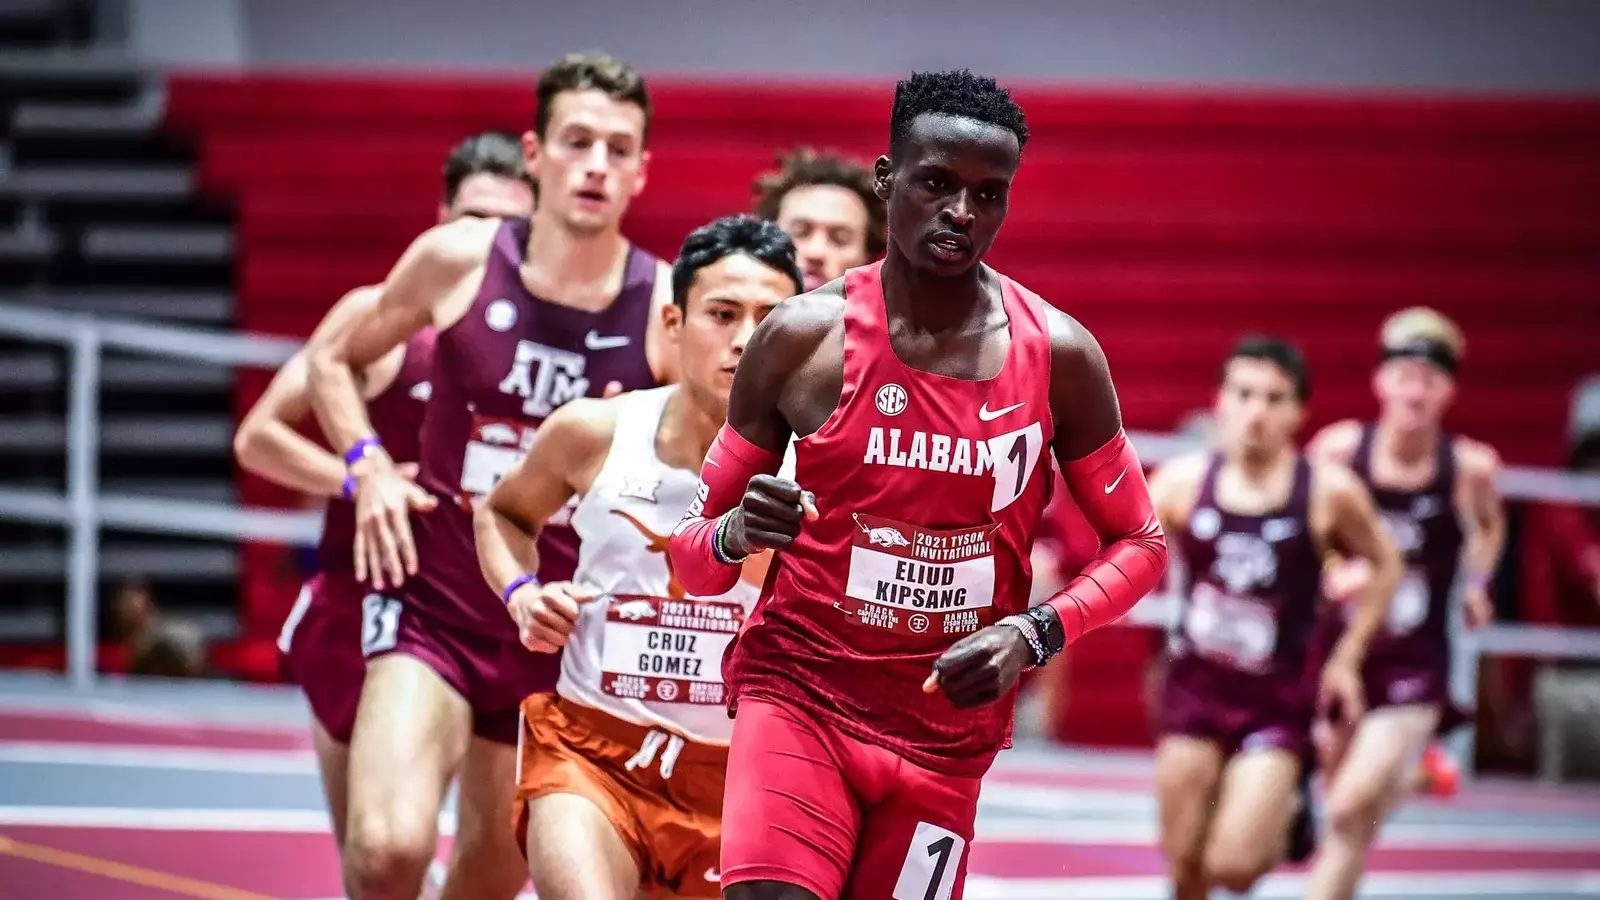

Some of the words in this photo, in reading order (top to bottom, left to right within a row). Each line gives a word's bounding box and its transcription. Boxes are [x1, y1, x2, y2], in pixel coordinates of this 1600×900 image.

[878, 386, 906, 414] SEC
[863, 427, 997, 478] ALABAM
[1007, 433, 1028, 498] 1
[915, 541, 991, 560] INVITATIONAL
[917, 533, 946, 549] 2021
[951, 531, 985, 547] TYSON
[895, 560, 955, 586] ELIUD
[875, 580, 967, 609] KIPSANG
[662, 601, 691, 616] 2021
[864, 603, 894, 616] TRACK
[861, 616, 894, 629] WORLD
[943, 624, 977, 633] CENTER
[648, 631, 697, 653] CRUZ
[638, 653, 703, 677] GOMEZ
[923, 836, 955, 900] 1
